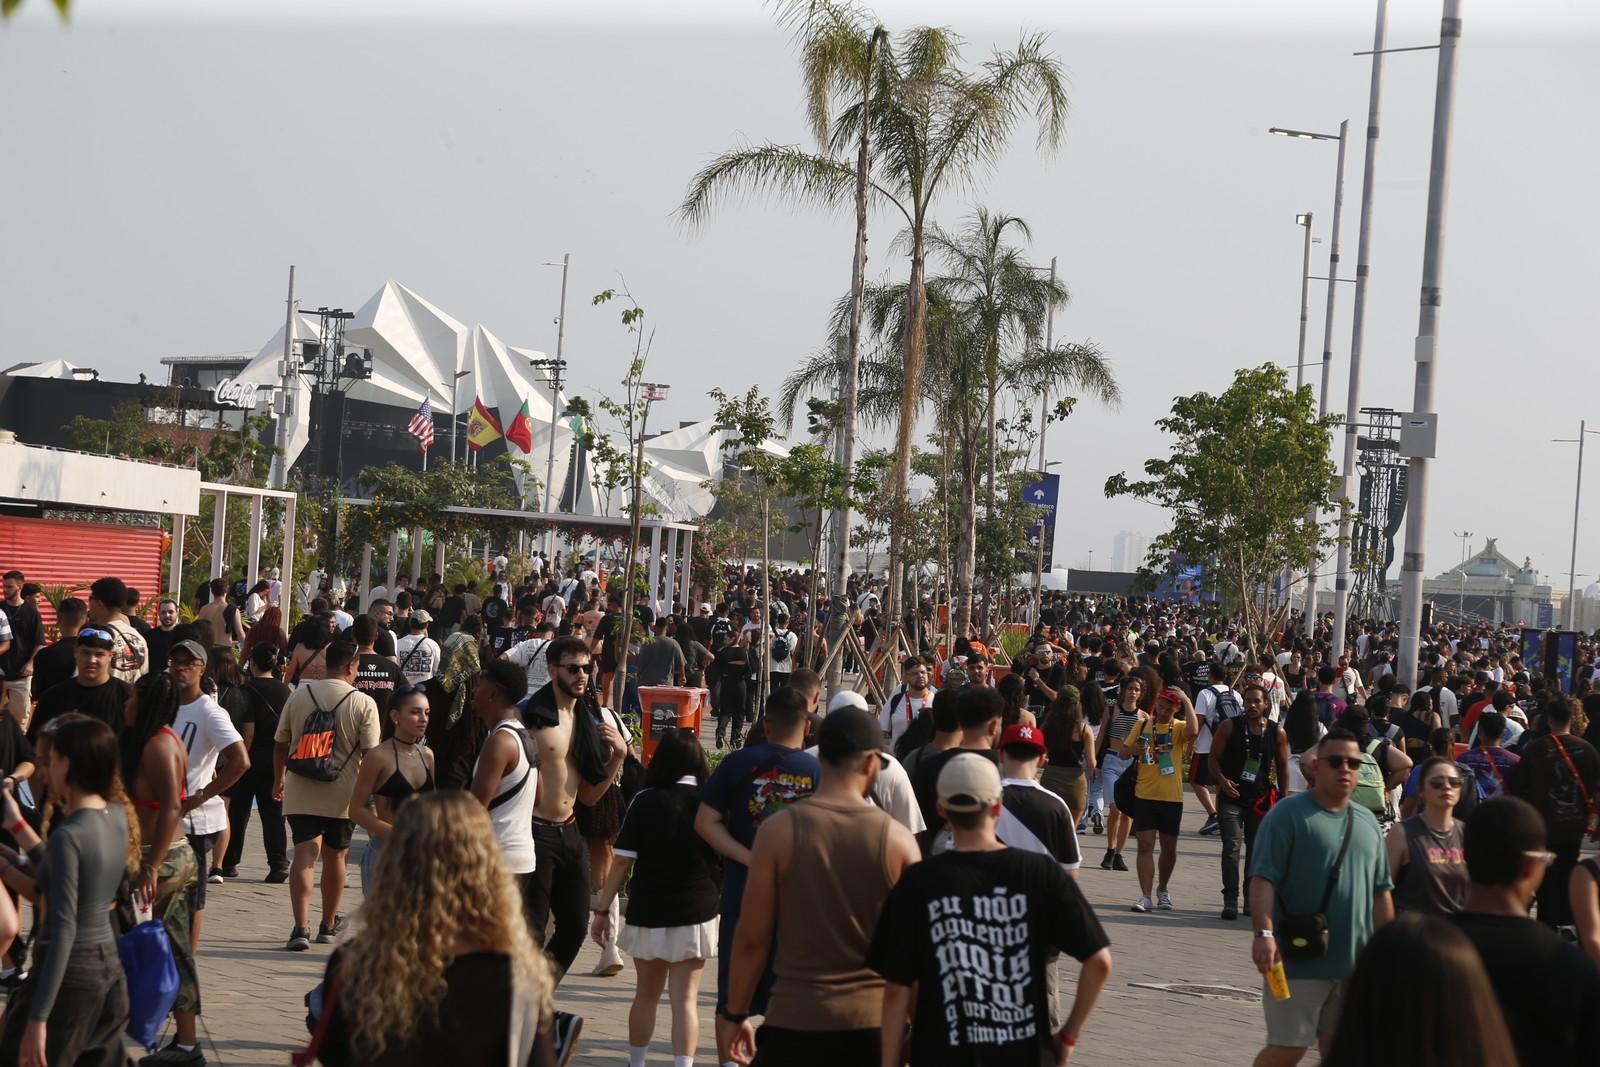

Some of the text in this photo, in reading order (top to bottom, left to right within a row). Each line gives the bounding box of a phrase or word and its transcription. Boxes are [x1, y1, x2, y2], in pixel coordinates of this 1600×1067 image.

[928, 886, 1028, 923] eu não
[930, 916, 1028, 947] aguento
[936, 940, 1031, 983] mais
[941, 969, 1032, 1009] errar
[945, 1001, 1035, 1024] a verdade
[949, 1021, 1036, 1046] é simples
